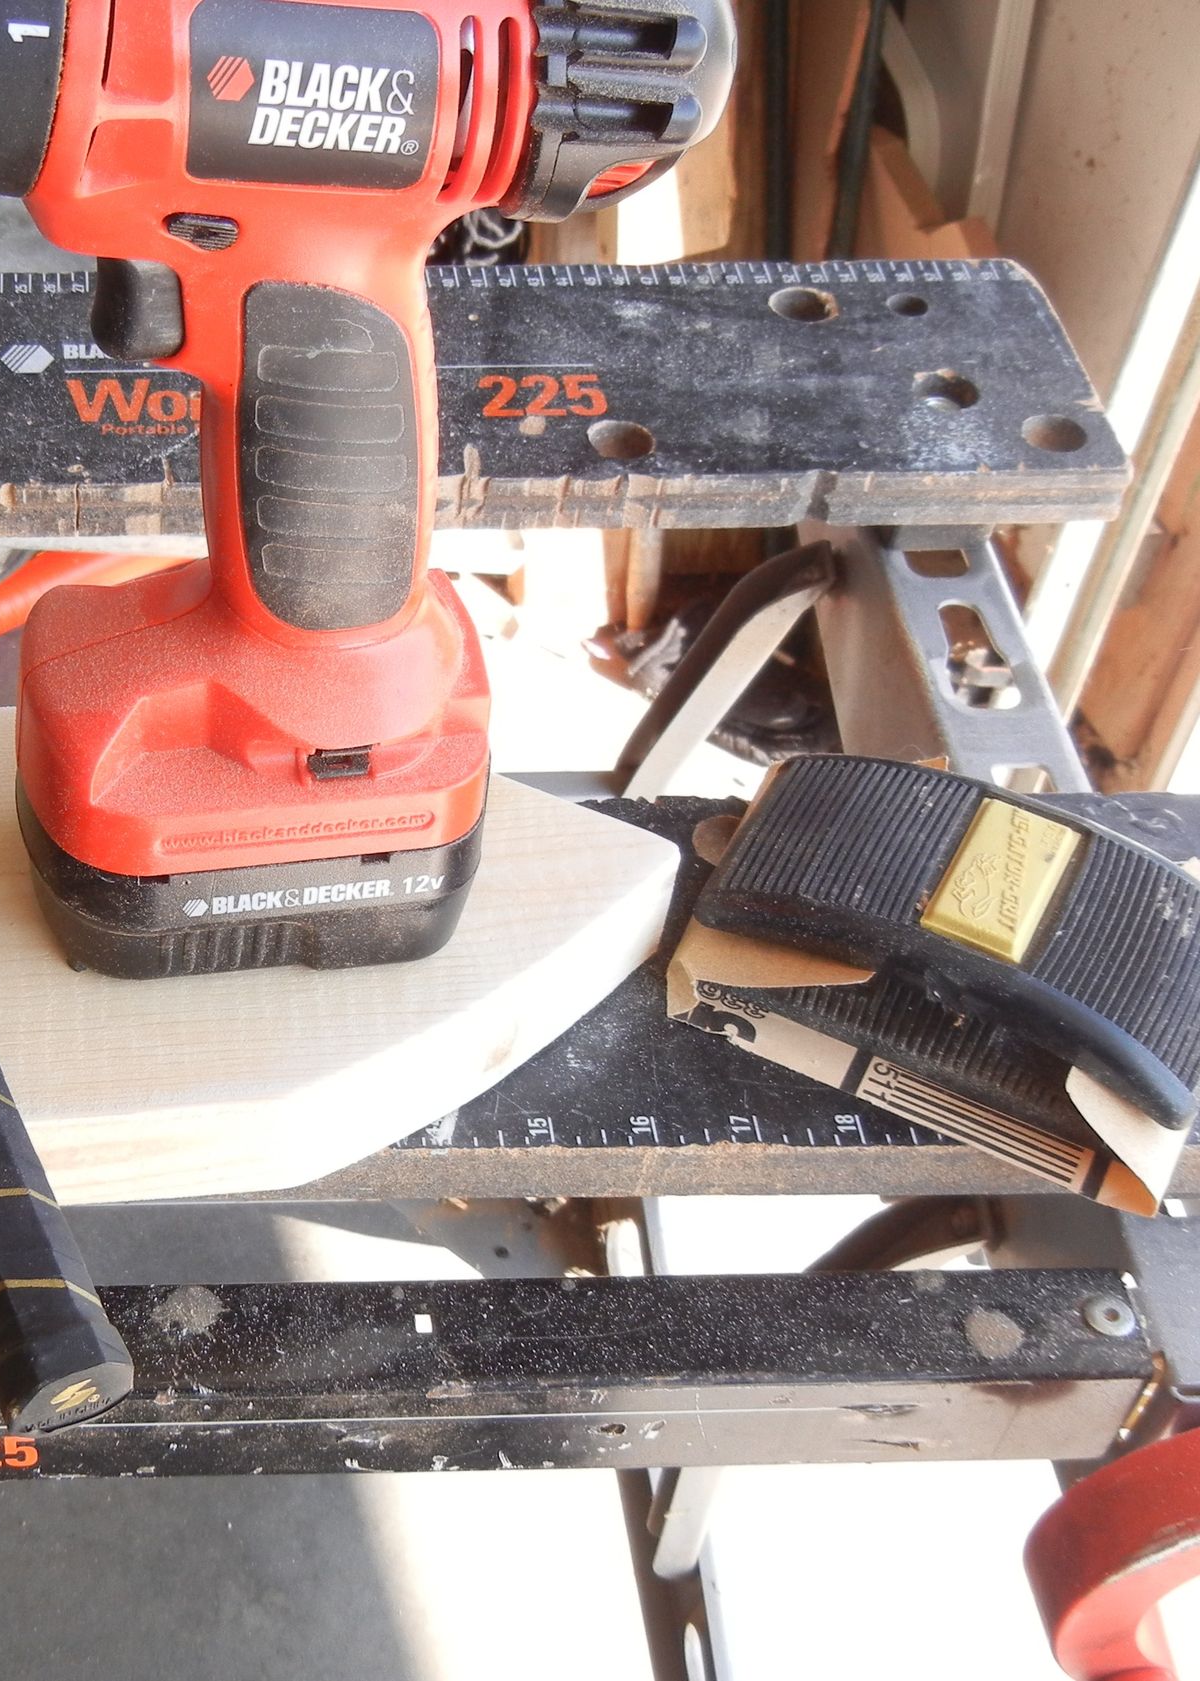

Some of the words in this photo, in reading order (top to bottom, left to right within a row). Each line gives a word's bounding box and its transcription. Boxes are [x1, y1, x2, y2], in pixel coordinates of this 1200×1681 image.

[257, 57, 415, 115] BLACK&
[62, 343, 114, 360] BLA
[476, 373, 608, 418] 225
[101, 422, 189, 436] Portable
[162, 812, 427, 848] www.blackanddecker.com
[402, 874, 446, 896] 12v
[527, 1117, 549, 1137] 15
[629, 1115, 650, 1134] 16
[731, 1115, 751, 1134] 17
[835, 1114, 856, 1134] 18
